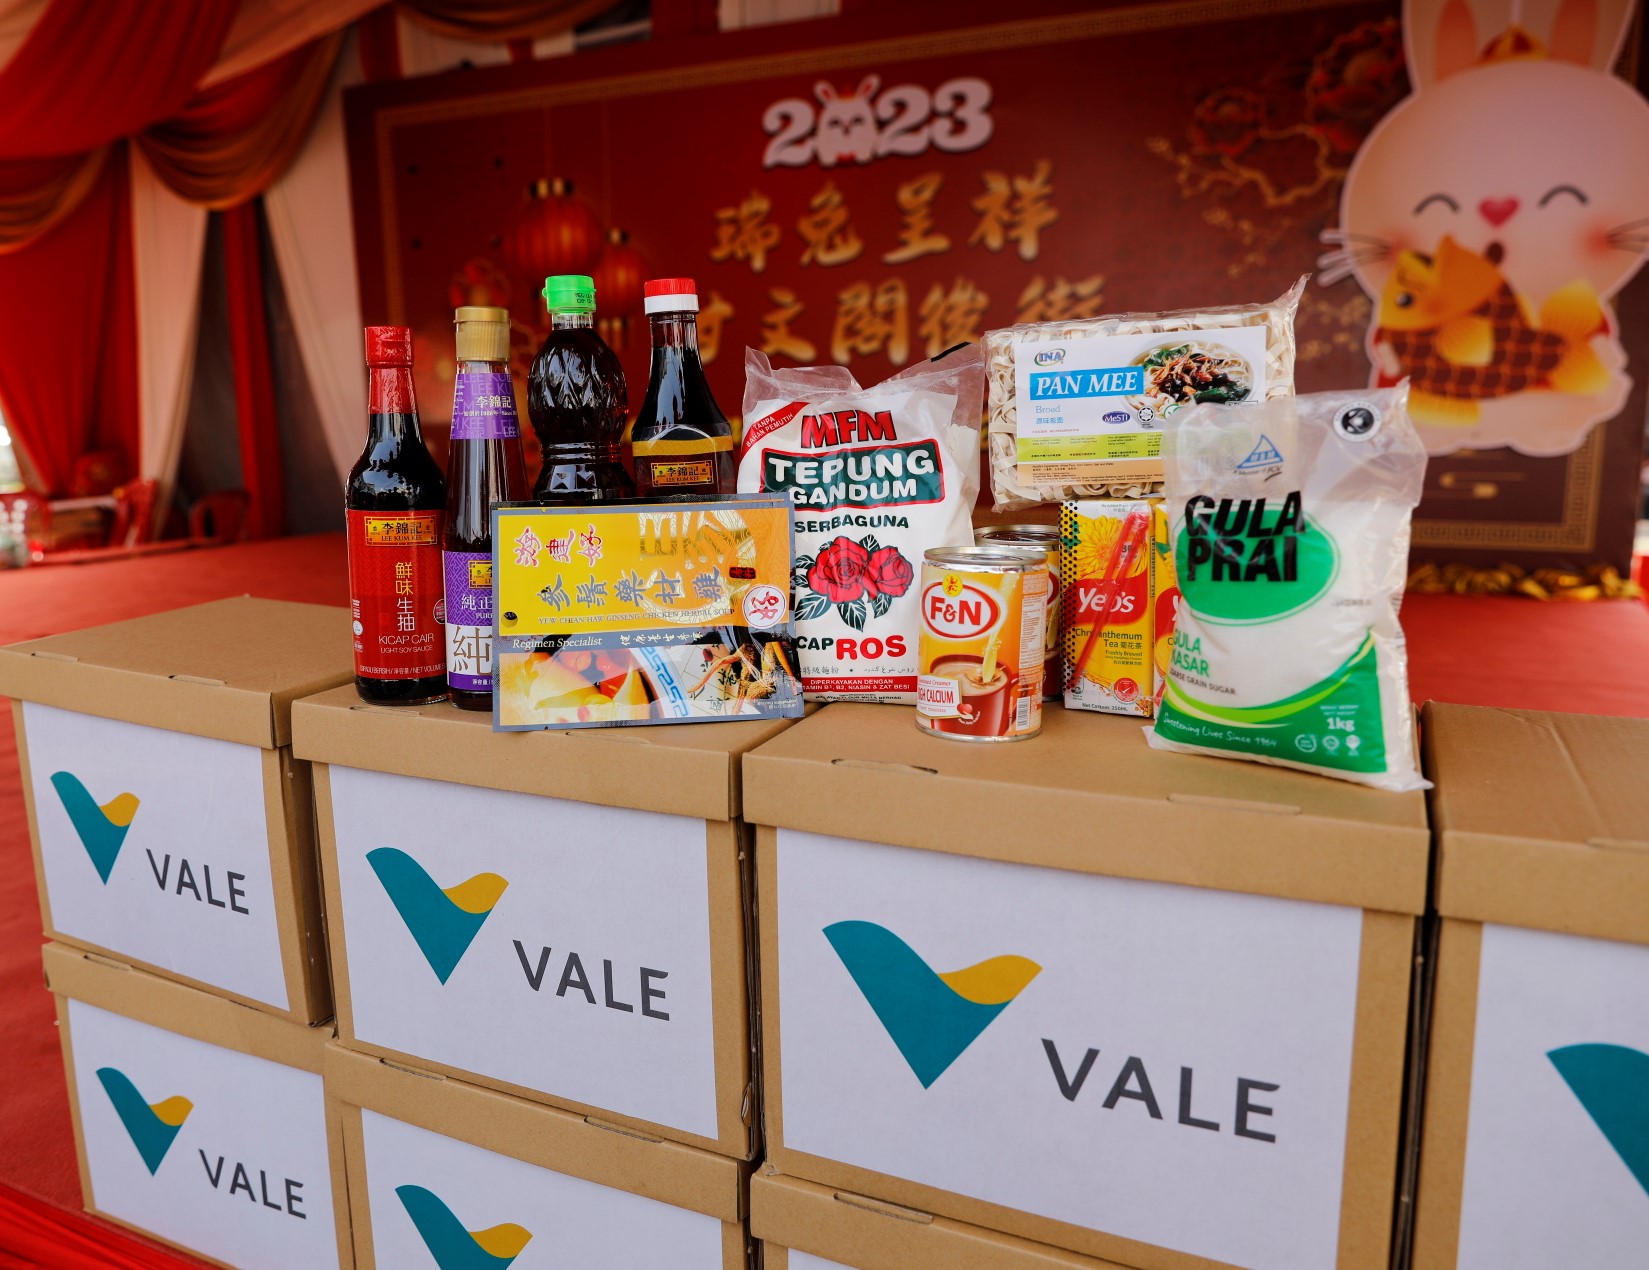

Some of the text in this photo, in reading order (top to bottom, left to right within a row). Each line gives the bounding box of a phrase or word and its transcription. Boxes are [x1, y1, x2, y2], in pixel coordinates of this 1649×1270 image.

[1038, 352, 1063, 363] INA
[1035, 371, 1138, 396] PAN MEE
[475, 395, 512, 408] 李錦記
[1035, 404, 1061, 414] Broad
[753, 415, 776, 430] TANPA
[1104, 414, 1128, 422] MeSTI
[746, 412, 794, 448] BAHAN PEMUTIH
[800, 410, 898, 449] MFM
[666, 465, 700, 477] 李錦記
[768, 449, 935, 485] TEPUNG
[788, 478, 917, 505] GANDUM
[794, 514, 909, 534] SERBAGUNA
[1184, 490, 1307, 538] GULA
[381, 521, 422, 535] 李錦記
[1187, 535, 1298, 582] PRAI
[395, 561, 415, 632] 鮮味生抽
[539, 607, 735, 625] YEW CHIAN HAW GINSENG CHICKEN HERBAL SOUP
[930, 595, 982, 626] F&N
[378, 633, 435, 645] KICAP CAIR
[412, 644, 433, 652] SAUCE
[512, 636, 603, 650] Regimen Specialist
[797, 634, 907, 660] CAP ROS
[1103, 639, 1119, 648] Tea
[1186, 675, 1207, 688] GRAIN
[1209, 682, 1237, 695] SUGAR
[926, 688, 954, 704] CALCIUM
[1163, 712, 1200, 736] Sweetening
[1201, 726, 1223, 739] Lives
[1226, 731, 1251, 743] Since
[1326, 717, 1356, 732] 1kg
[145, 848, 250, 915] VALE
[512, 939, 670, 1022] VALE
[1041, 1038, 1280, 1144] VALE
[198, 1149, 307, 1220] VALE
